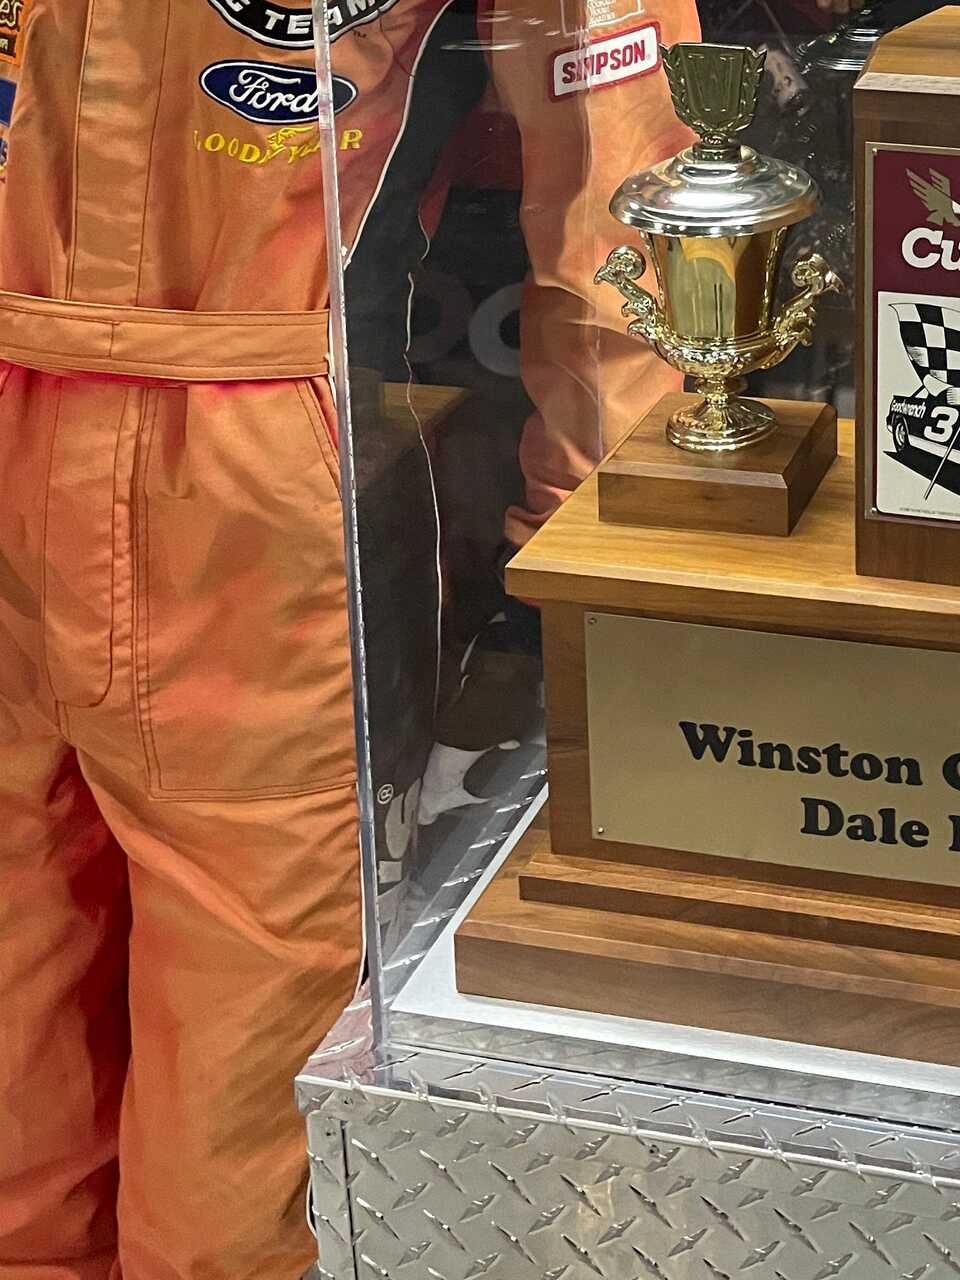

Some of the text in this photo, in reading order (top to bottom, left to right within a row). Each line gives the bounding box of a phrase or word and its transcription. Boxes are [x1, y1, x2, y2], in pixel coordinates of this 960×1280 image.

[228, 69, 319, 113] Ford
[924, 406, 959, 443] 3
[678, 720, 924, 787] Winston
[798, 796, 931, 849] Dale
